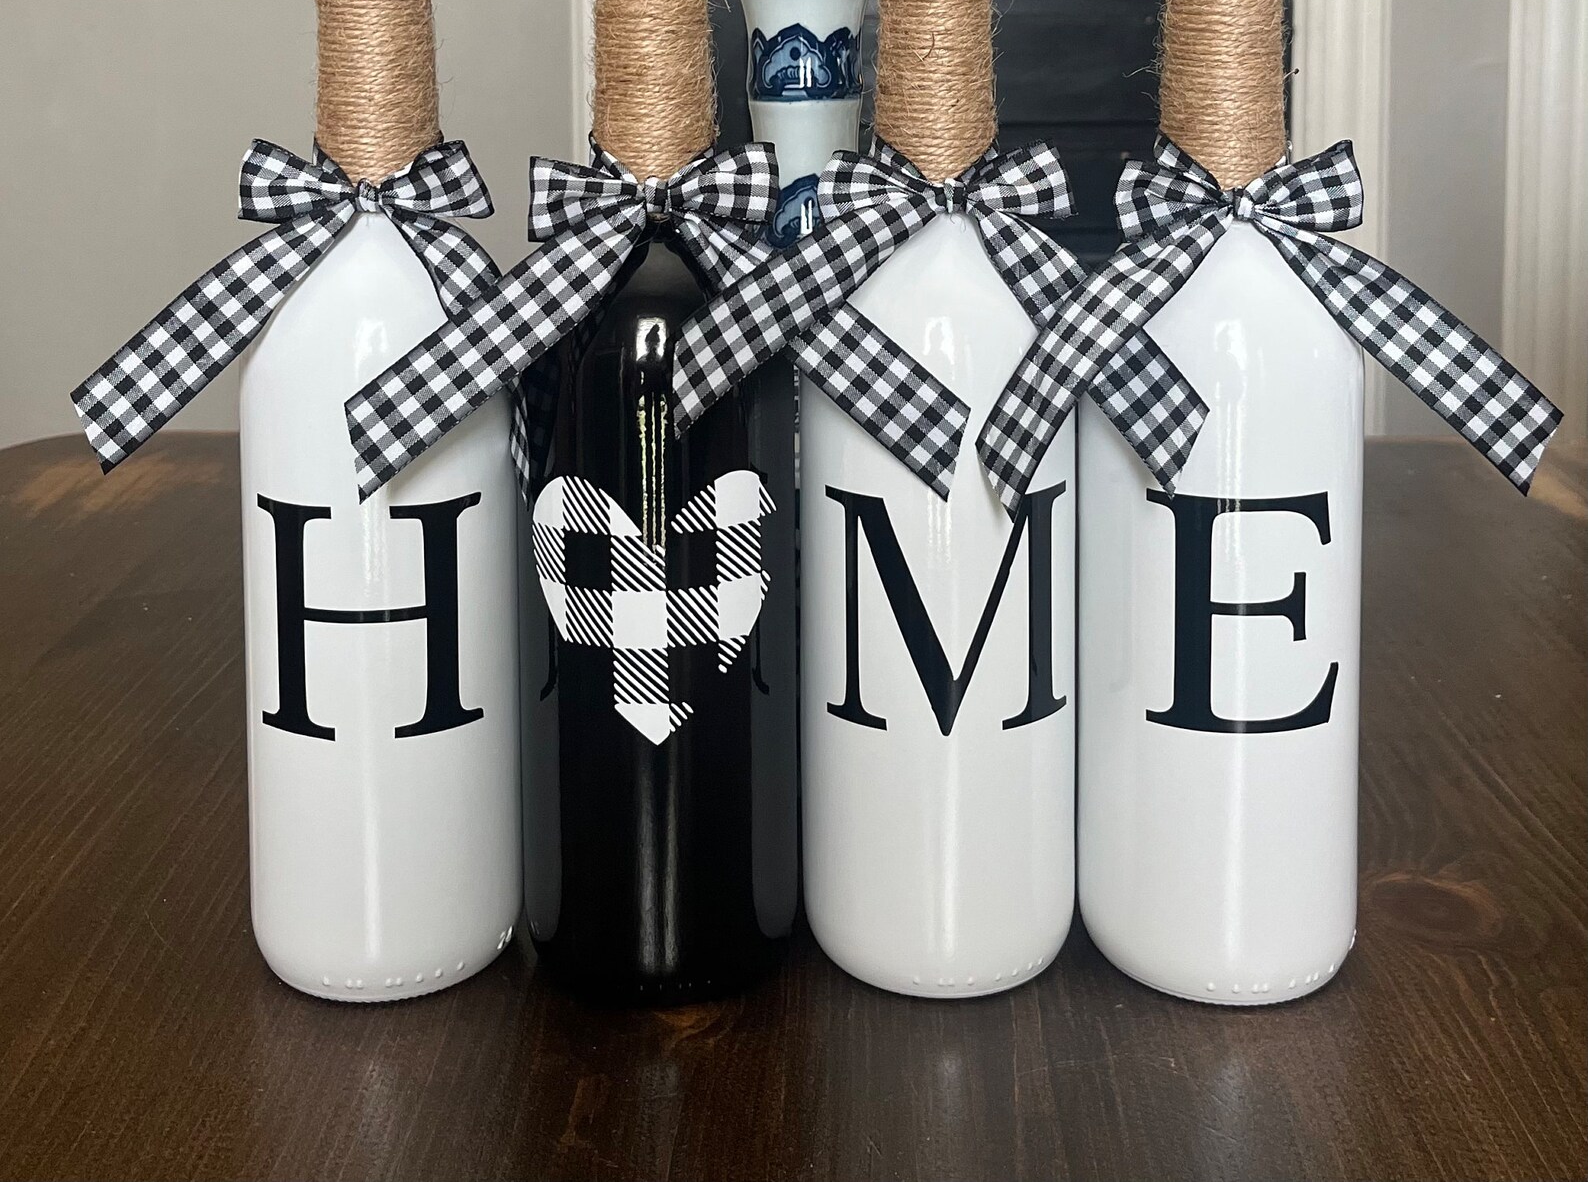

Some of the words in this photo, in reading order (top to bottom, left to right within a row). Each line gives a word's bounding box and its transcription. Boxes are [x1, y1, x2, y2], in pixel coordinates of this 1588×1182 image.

[257, 492, 484, 741] H
[825, 480, 1067, 736] M
[1146, 489, 1339, 734] E
